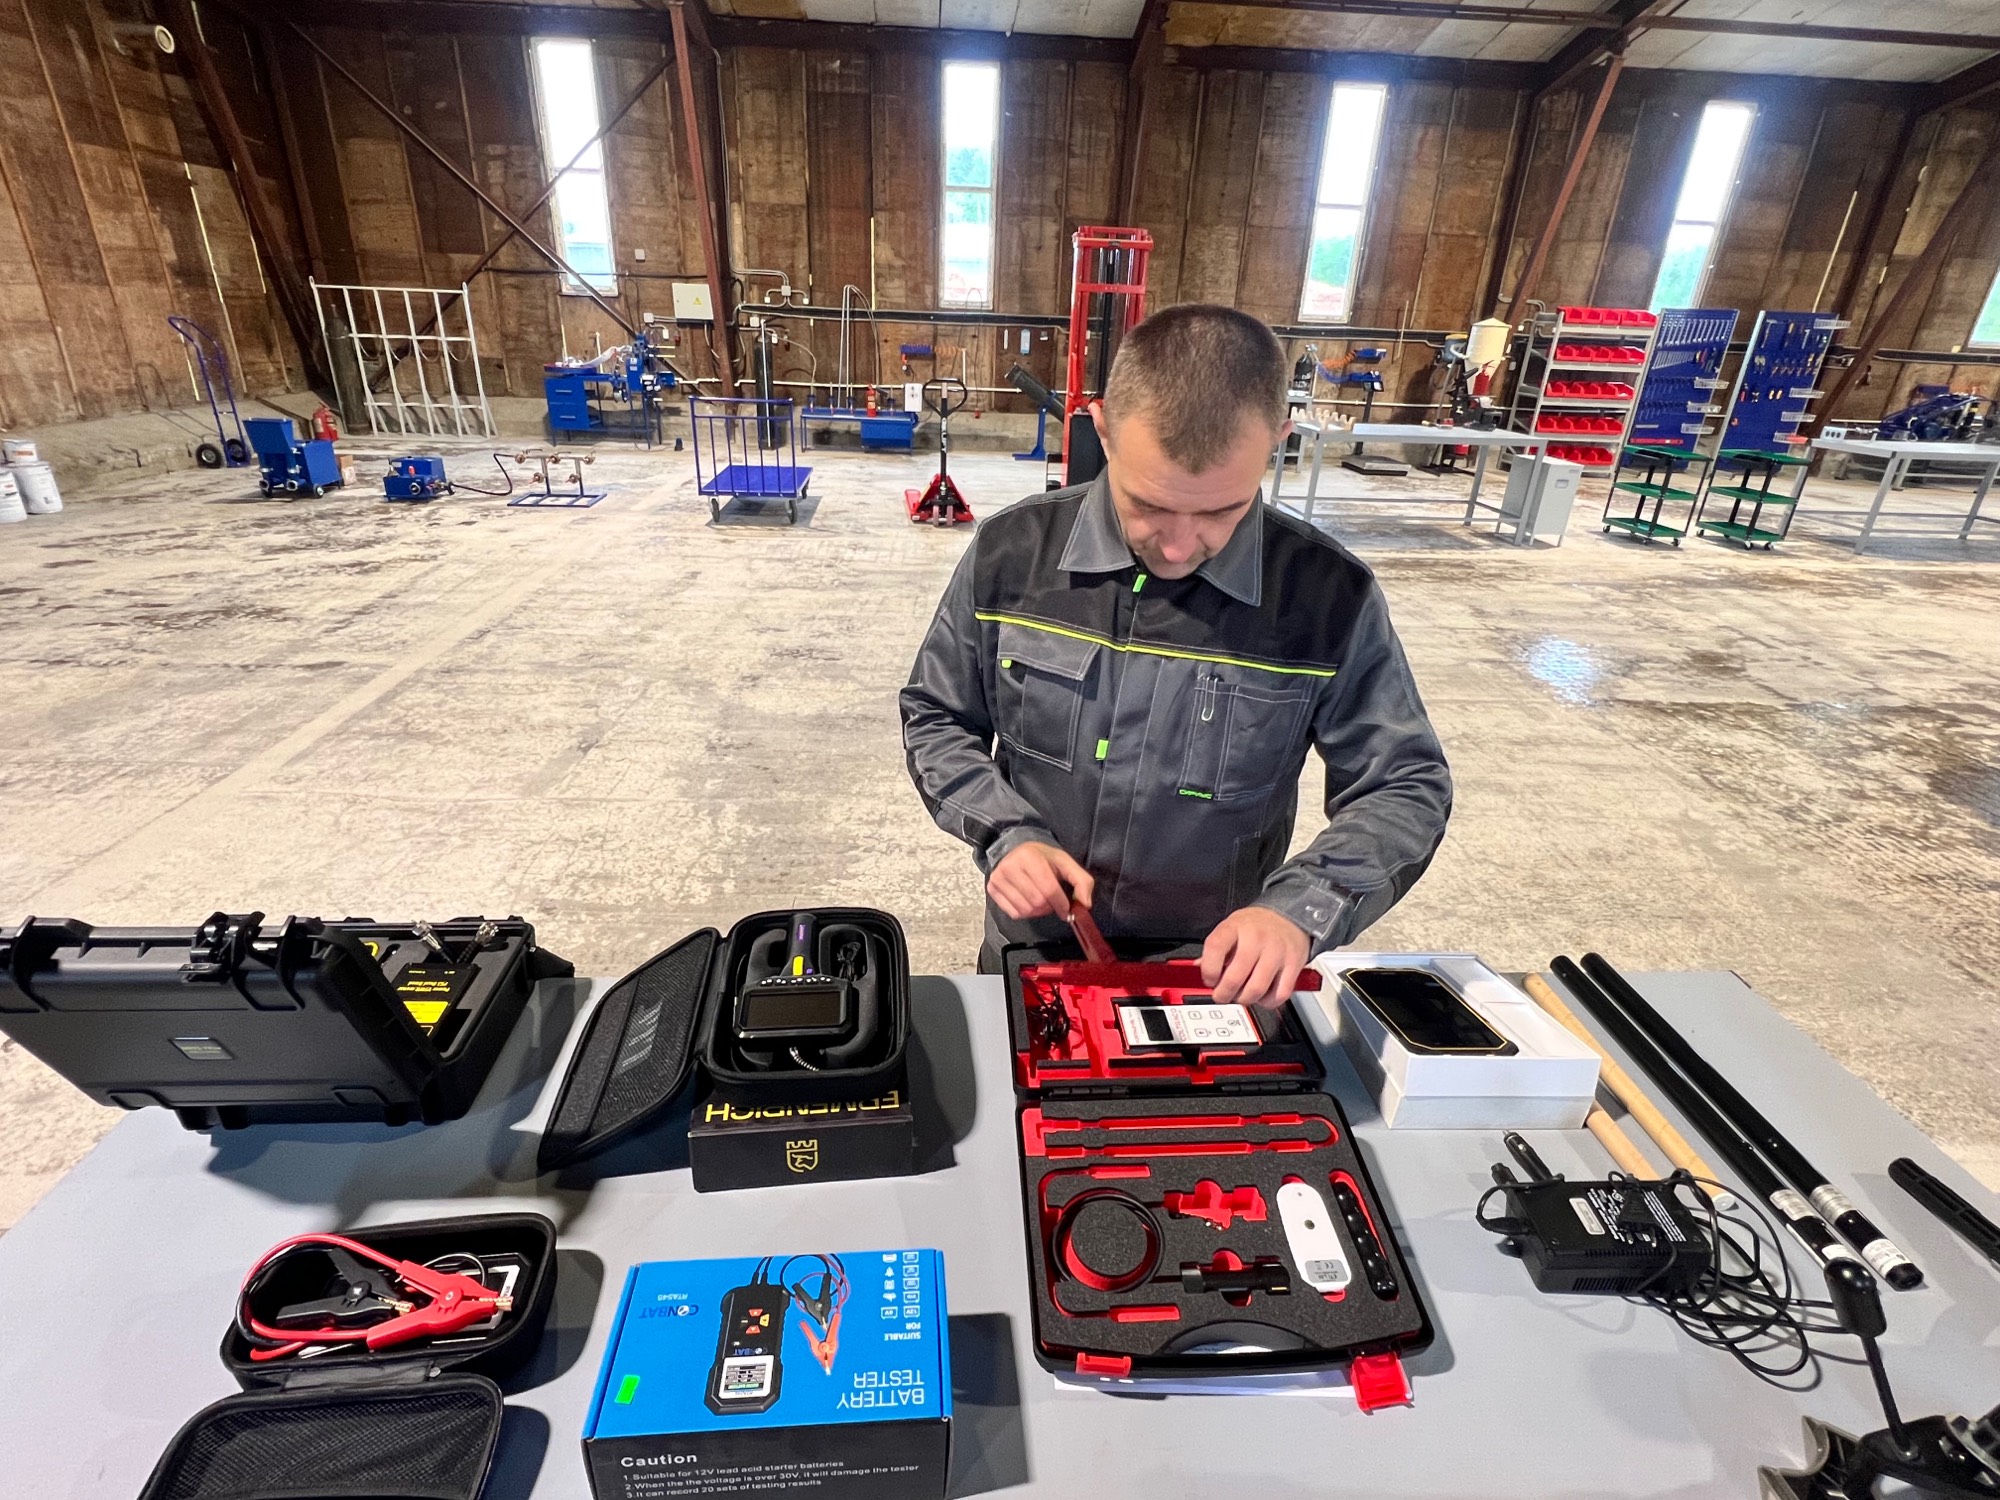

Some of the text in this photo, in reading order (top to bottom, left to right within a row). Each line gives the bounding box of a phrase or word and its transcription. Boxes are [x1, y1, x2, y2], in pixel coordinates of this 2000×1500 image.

[658, 1293, 688, 1302] RTA545
[638, 1304, 699, 1319] CONBAT
[884, 1332, 921, 1341] SUITABLE
[854, 1369, 924, 1389] TESTER
[836, 1388, 924, 1409] BATTERY
[620, 1454, 698, 1467] Caution
[704, 1476, 741, 1485] voltage
[831, 1468, 870, 1476] damage
[667, 1488, 699, 1496] record
[752, 1482, 786, 1490] testing
